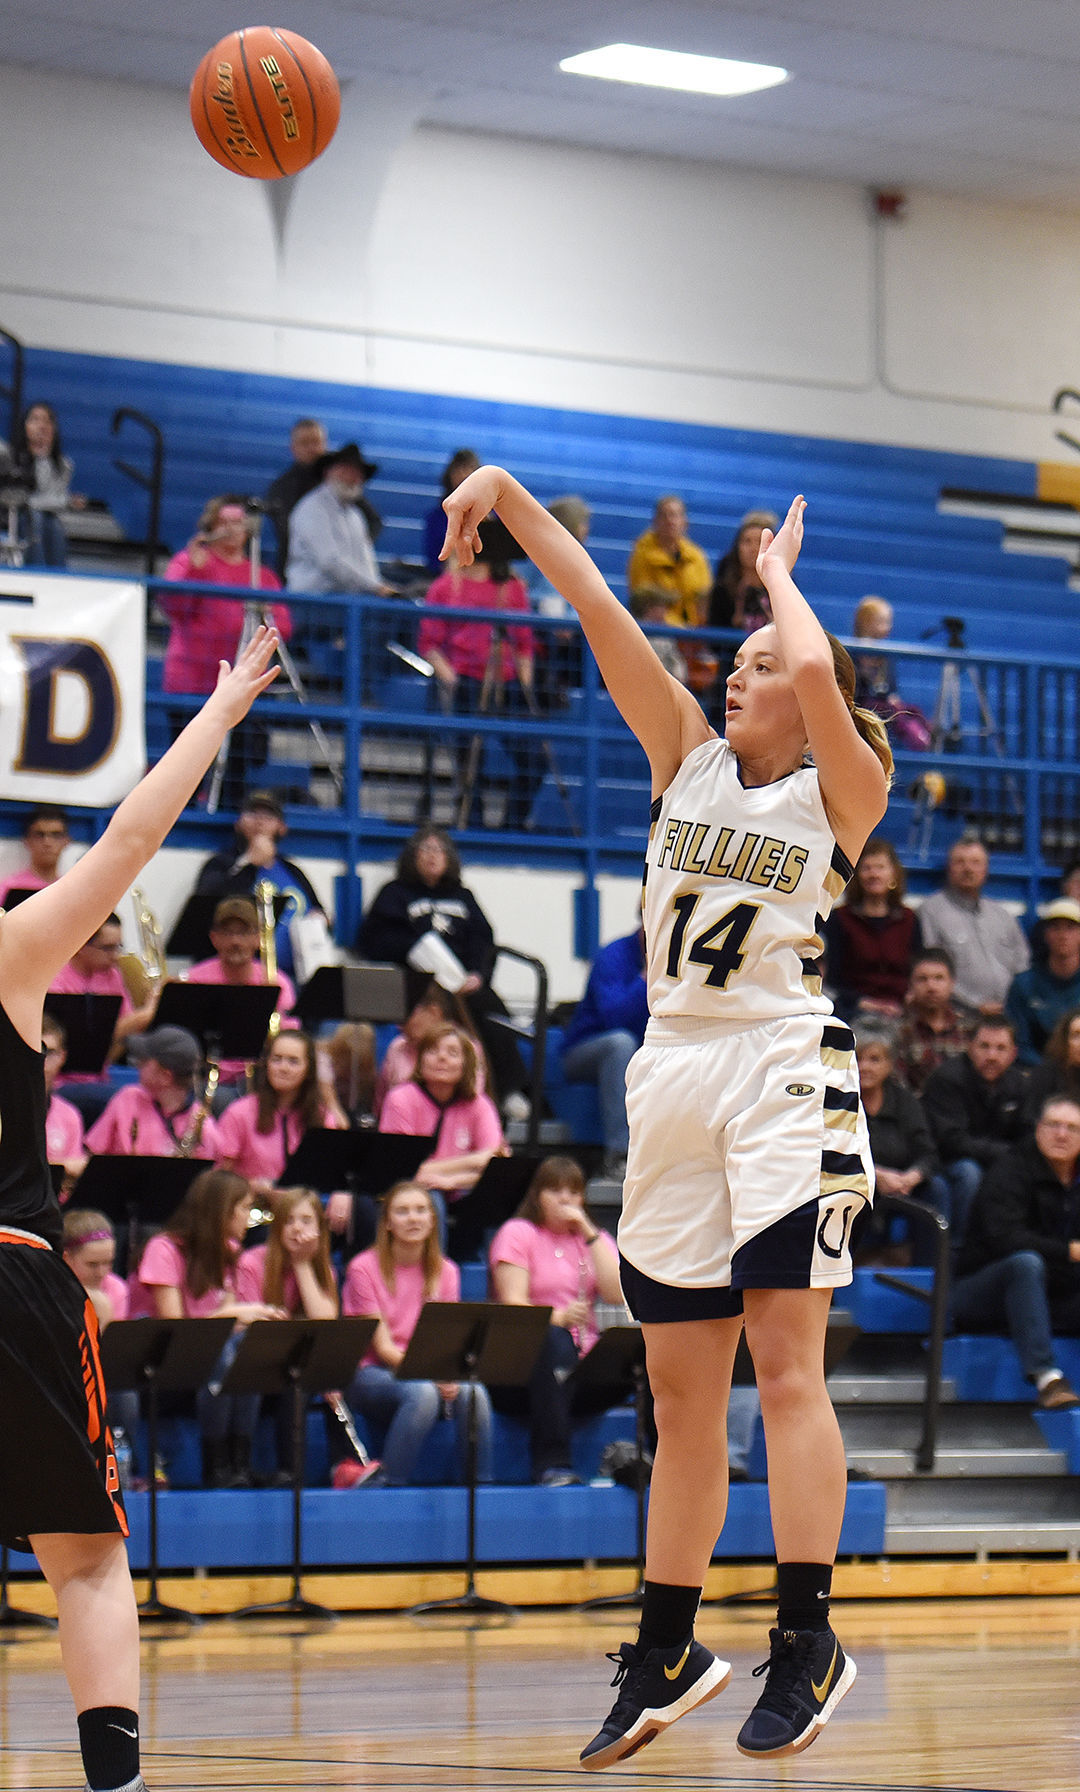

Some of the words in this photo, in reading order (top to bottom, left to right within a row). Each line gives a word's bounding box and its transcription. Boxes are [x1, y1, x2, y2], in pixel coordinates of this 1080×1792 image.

[213, 61, 262, 158] Baden
[259, 55, 299, 142] ELITE
[9, 633, 122, 776] D
[657, 818, 809, 894] FILLIES
[665, 890, 764, 991] 14
